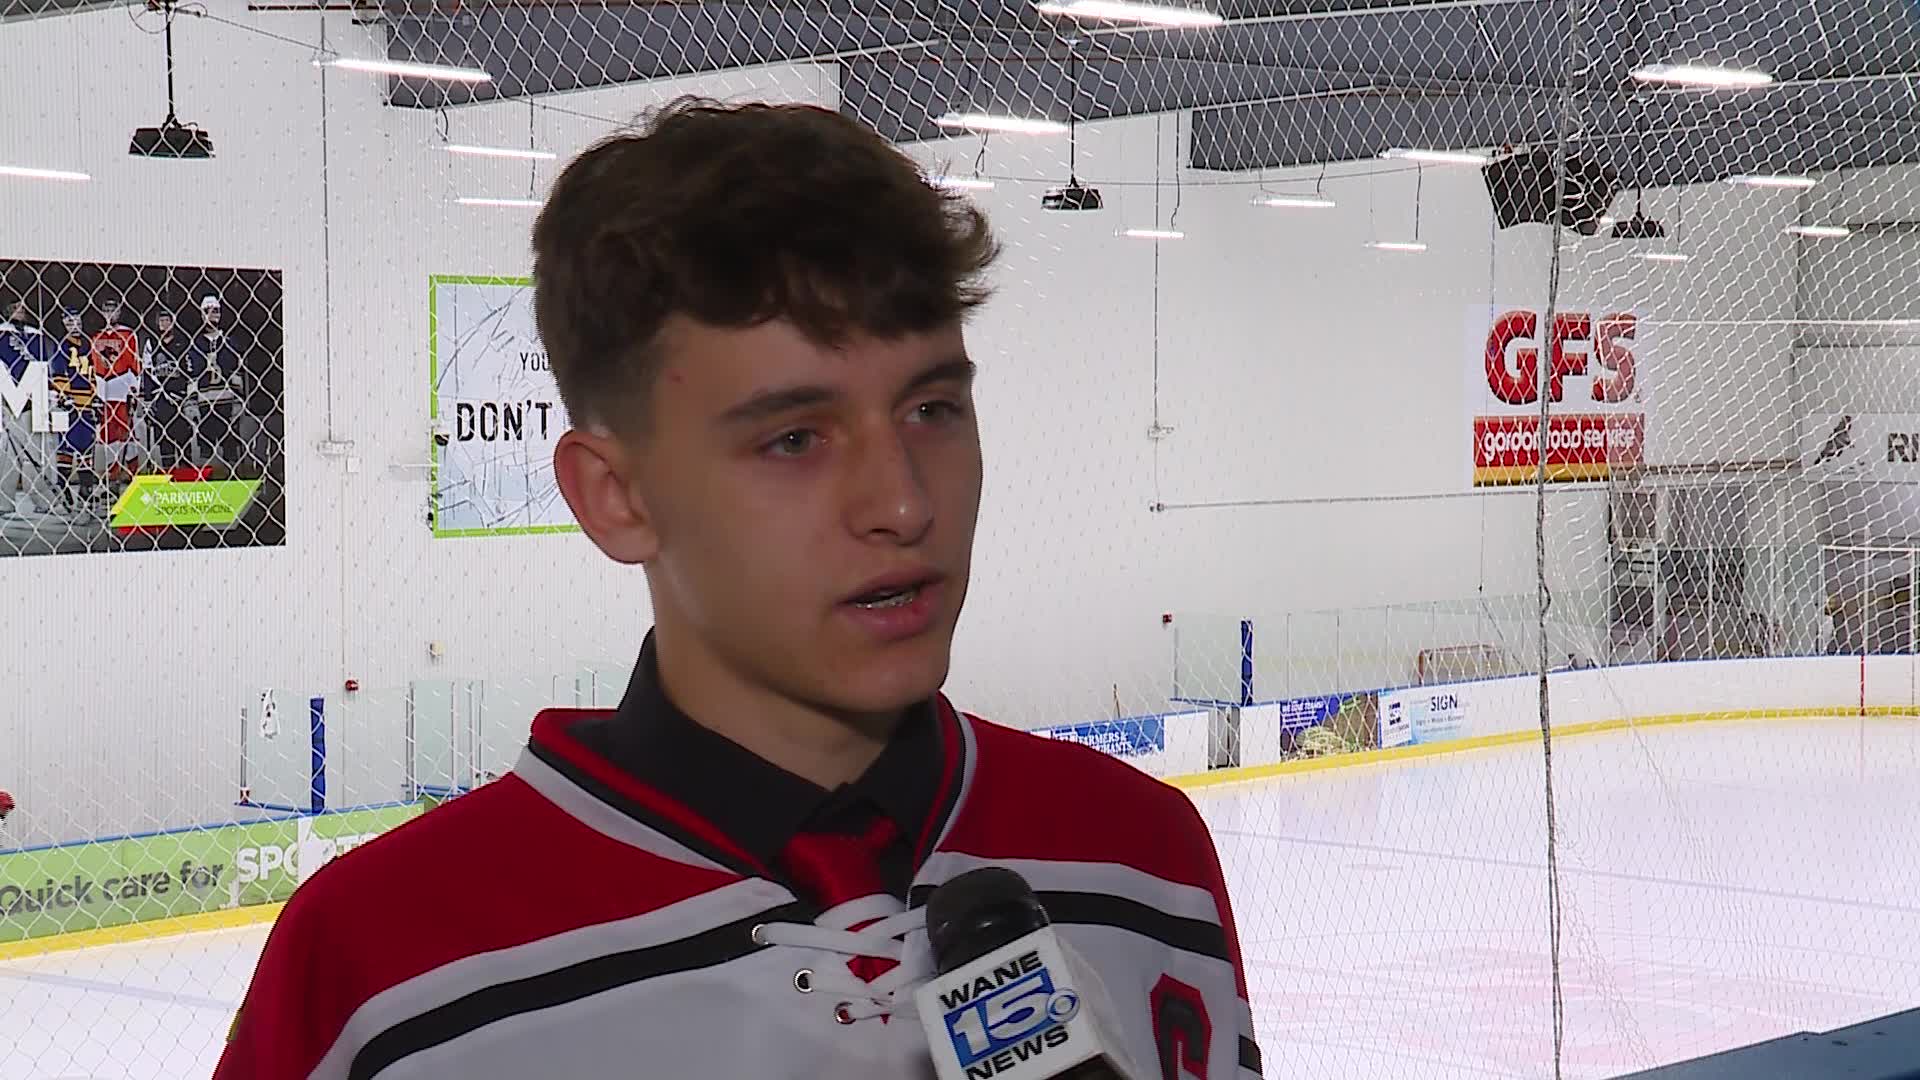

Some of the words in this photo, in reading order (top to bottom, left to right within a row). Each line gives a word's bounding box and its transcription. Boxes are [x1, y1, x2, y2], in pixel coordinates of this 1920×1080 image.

[1485, 310, 1638, 405] GFS
[456, 399, 553, 441] DON'T
[1484, 421, 1542, 461] gordon
[1545, 420, 1581, 449] food
[1584, 424, 1635, 449] service
[154, 491, 214, 504] PARKVIEW
[156, 504, 189, 515] SPORTS
[191, 503, 232, 514] MEDICINE
[1430, 694, 1458, 712] SIGN
[1079, 732, 1119, 745] FARMERS
[0, 875, 94, 917] Quick
[103, 867, 170, 902] care
[178, 860, 225, 890] for
[940, 949, 1043, 1009] WANE
[952, 973, 1048, 1057] 15
[964, 1025, 1070, 1080] NEWS
